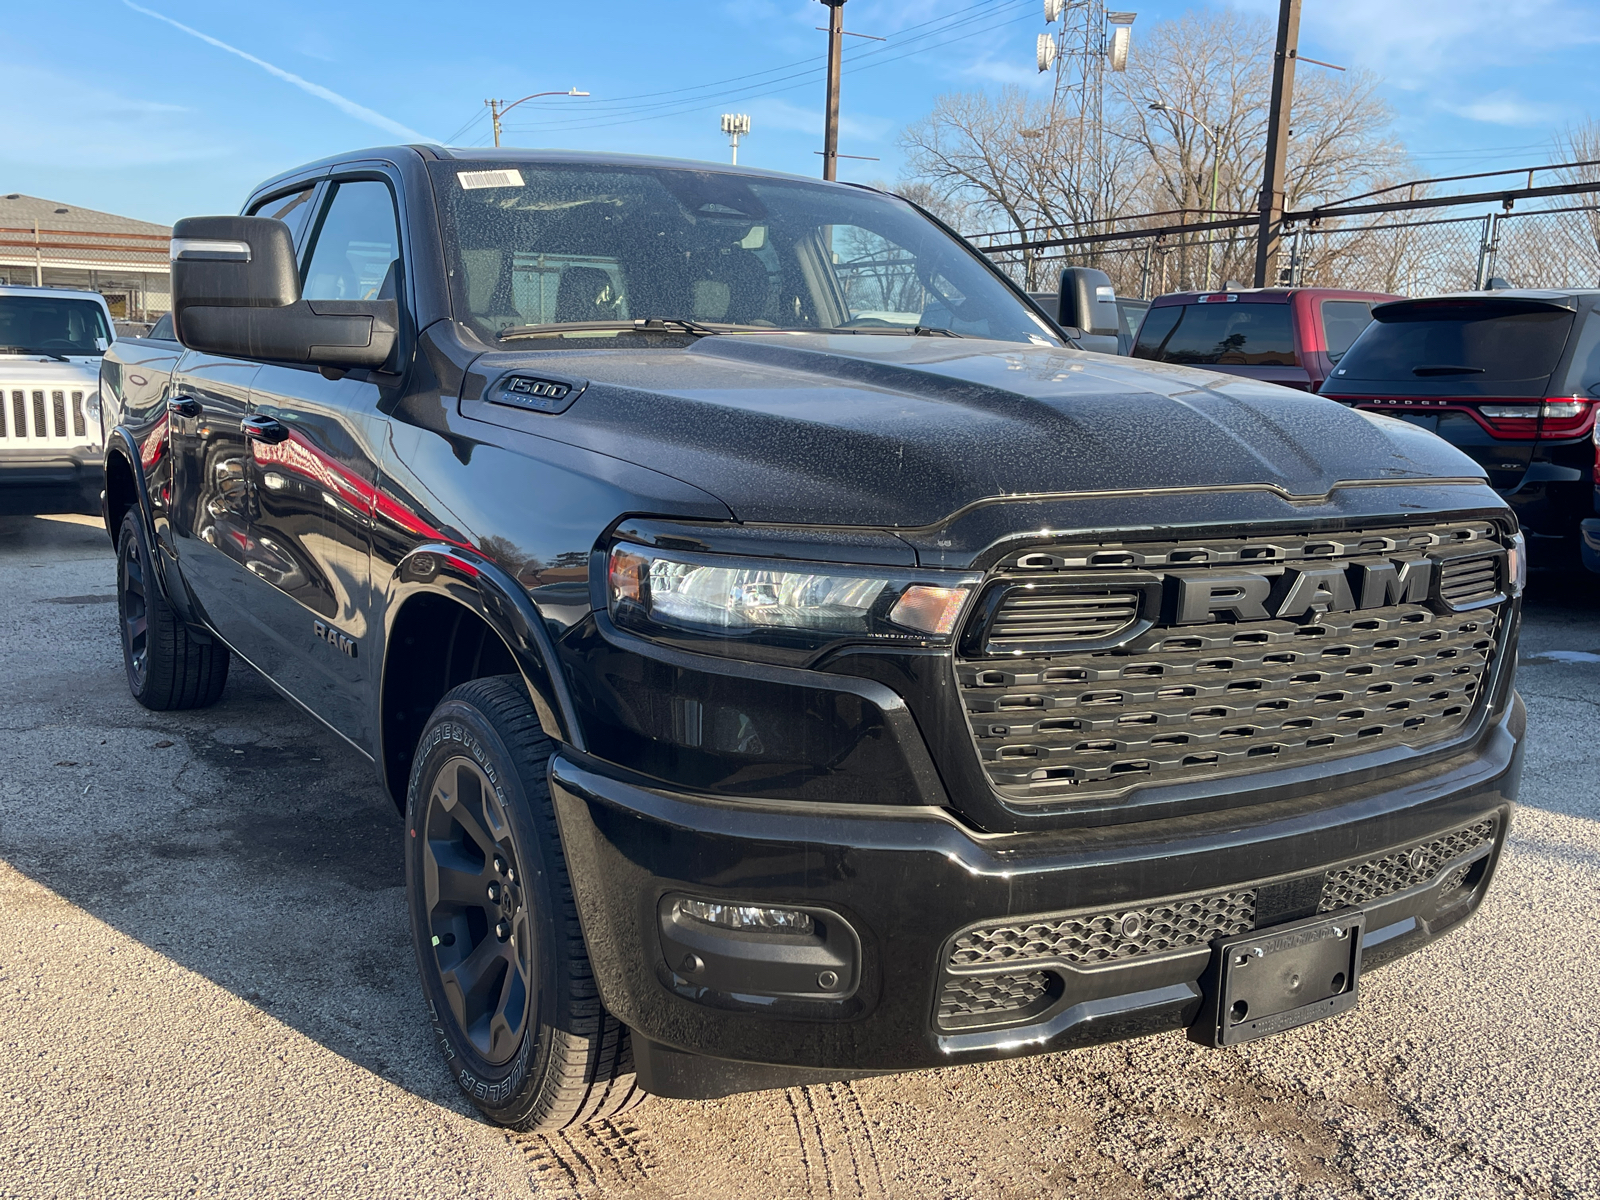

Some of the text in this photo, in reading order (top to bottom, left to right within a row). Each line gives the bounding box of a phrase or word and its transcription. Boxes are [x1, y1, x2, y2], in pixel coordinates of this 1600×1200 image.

[508, 377, 568, 398] 1500
[1176, 558, 1432, 625] RAM
[313, 619, 357, 658] RAM
[407, 722, 509, 816] BRIDGESTONE
[458, 1029, 531, 1102] DUELER
